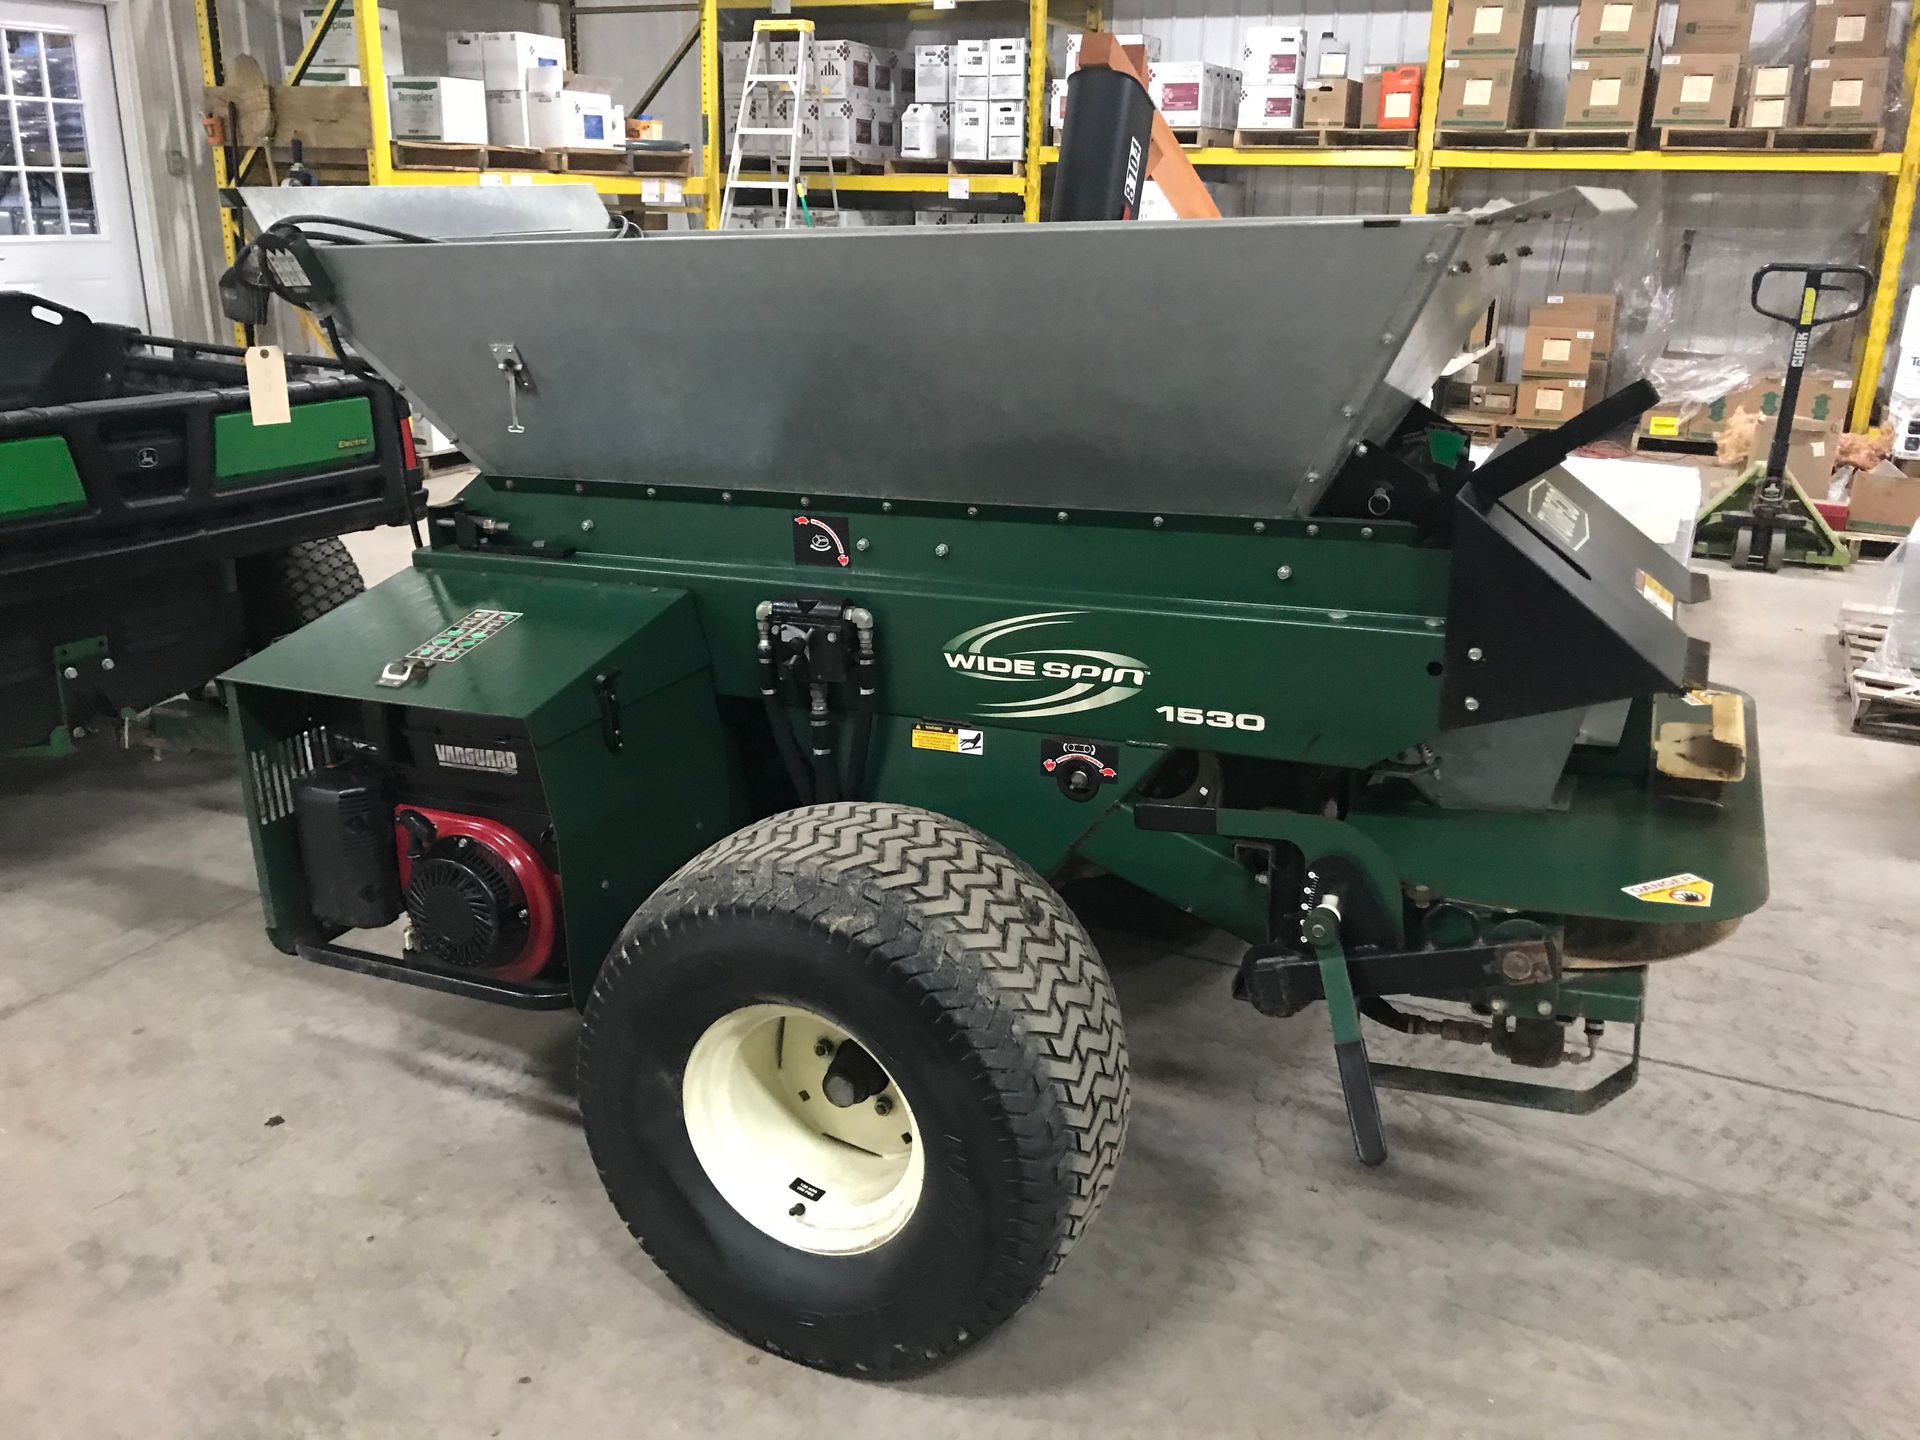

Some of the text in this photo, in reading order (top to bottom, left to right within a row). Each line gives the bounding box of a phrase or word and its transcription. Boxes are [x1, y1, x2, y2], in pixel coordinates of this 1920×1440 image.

[310, 20, 353, 31] Tplex
[1791, 331, 1809, 368] CLARK
[943, 652, 1036, 676] WIDE
[1155, 705, 1266, 732] 1530
[434, 743, 518, 769] VANGUARD
[1629, 875, 1694, 895] DANGER
